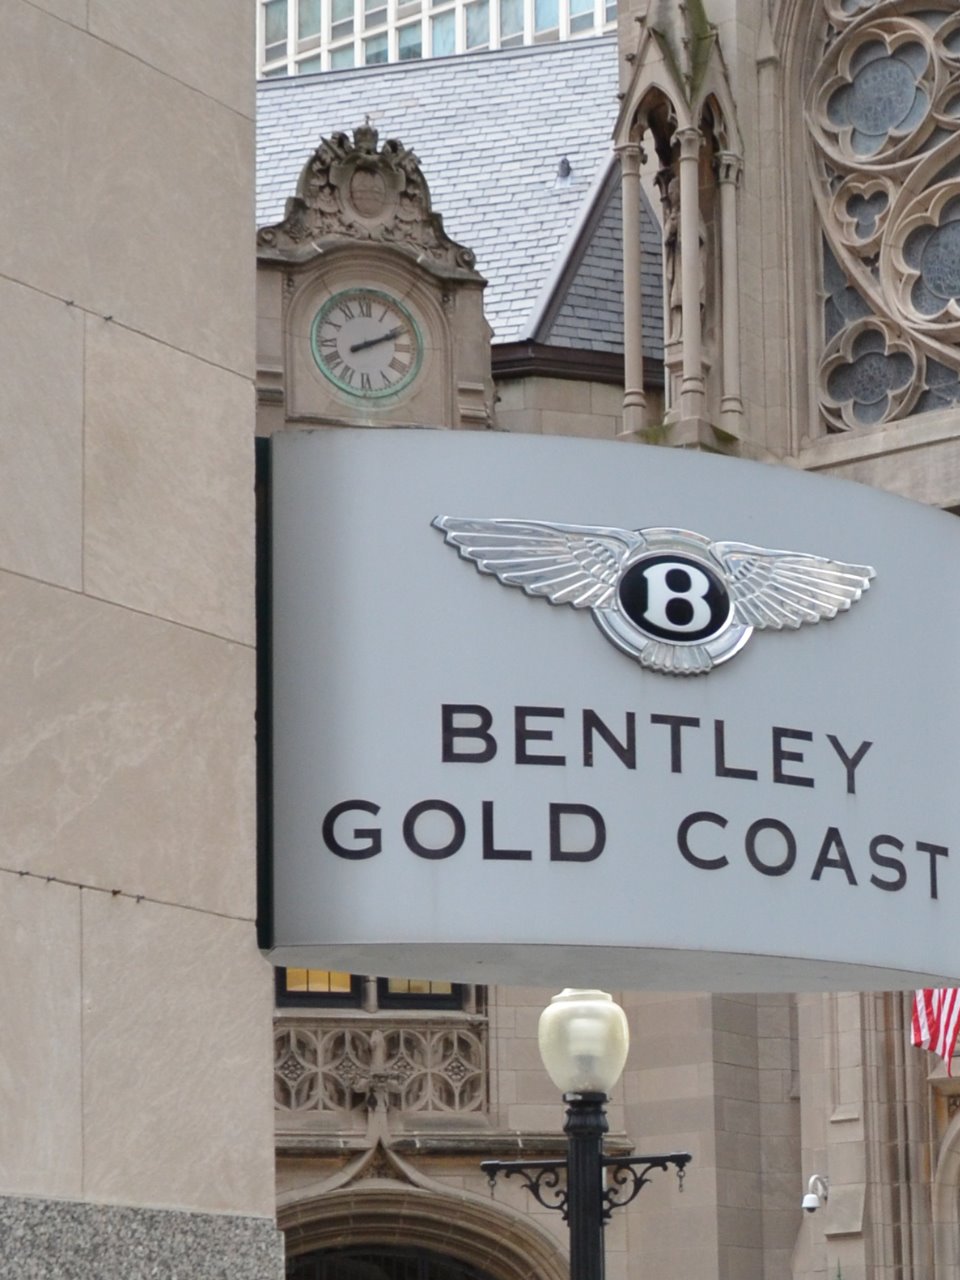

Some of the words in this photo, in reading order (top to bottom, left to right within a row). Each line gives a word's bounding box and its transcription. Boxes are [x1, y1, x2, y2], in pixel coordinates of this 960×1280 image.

[643, 562, 713, 633] B
[441, 703, 874, 794] BENTLEY
[322, 799, 607, 862] GOLD
[677, 811, 949, 899] COAST
